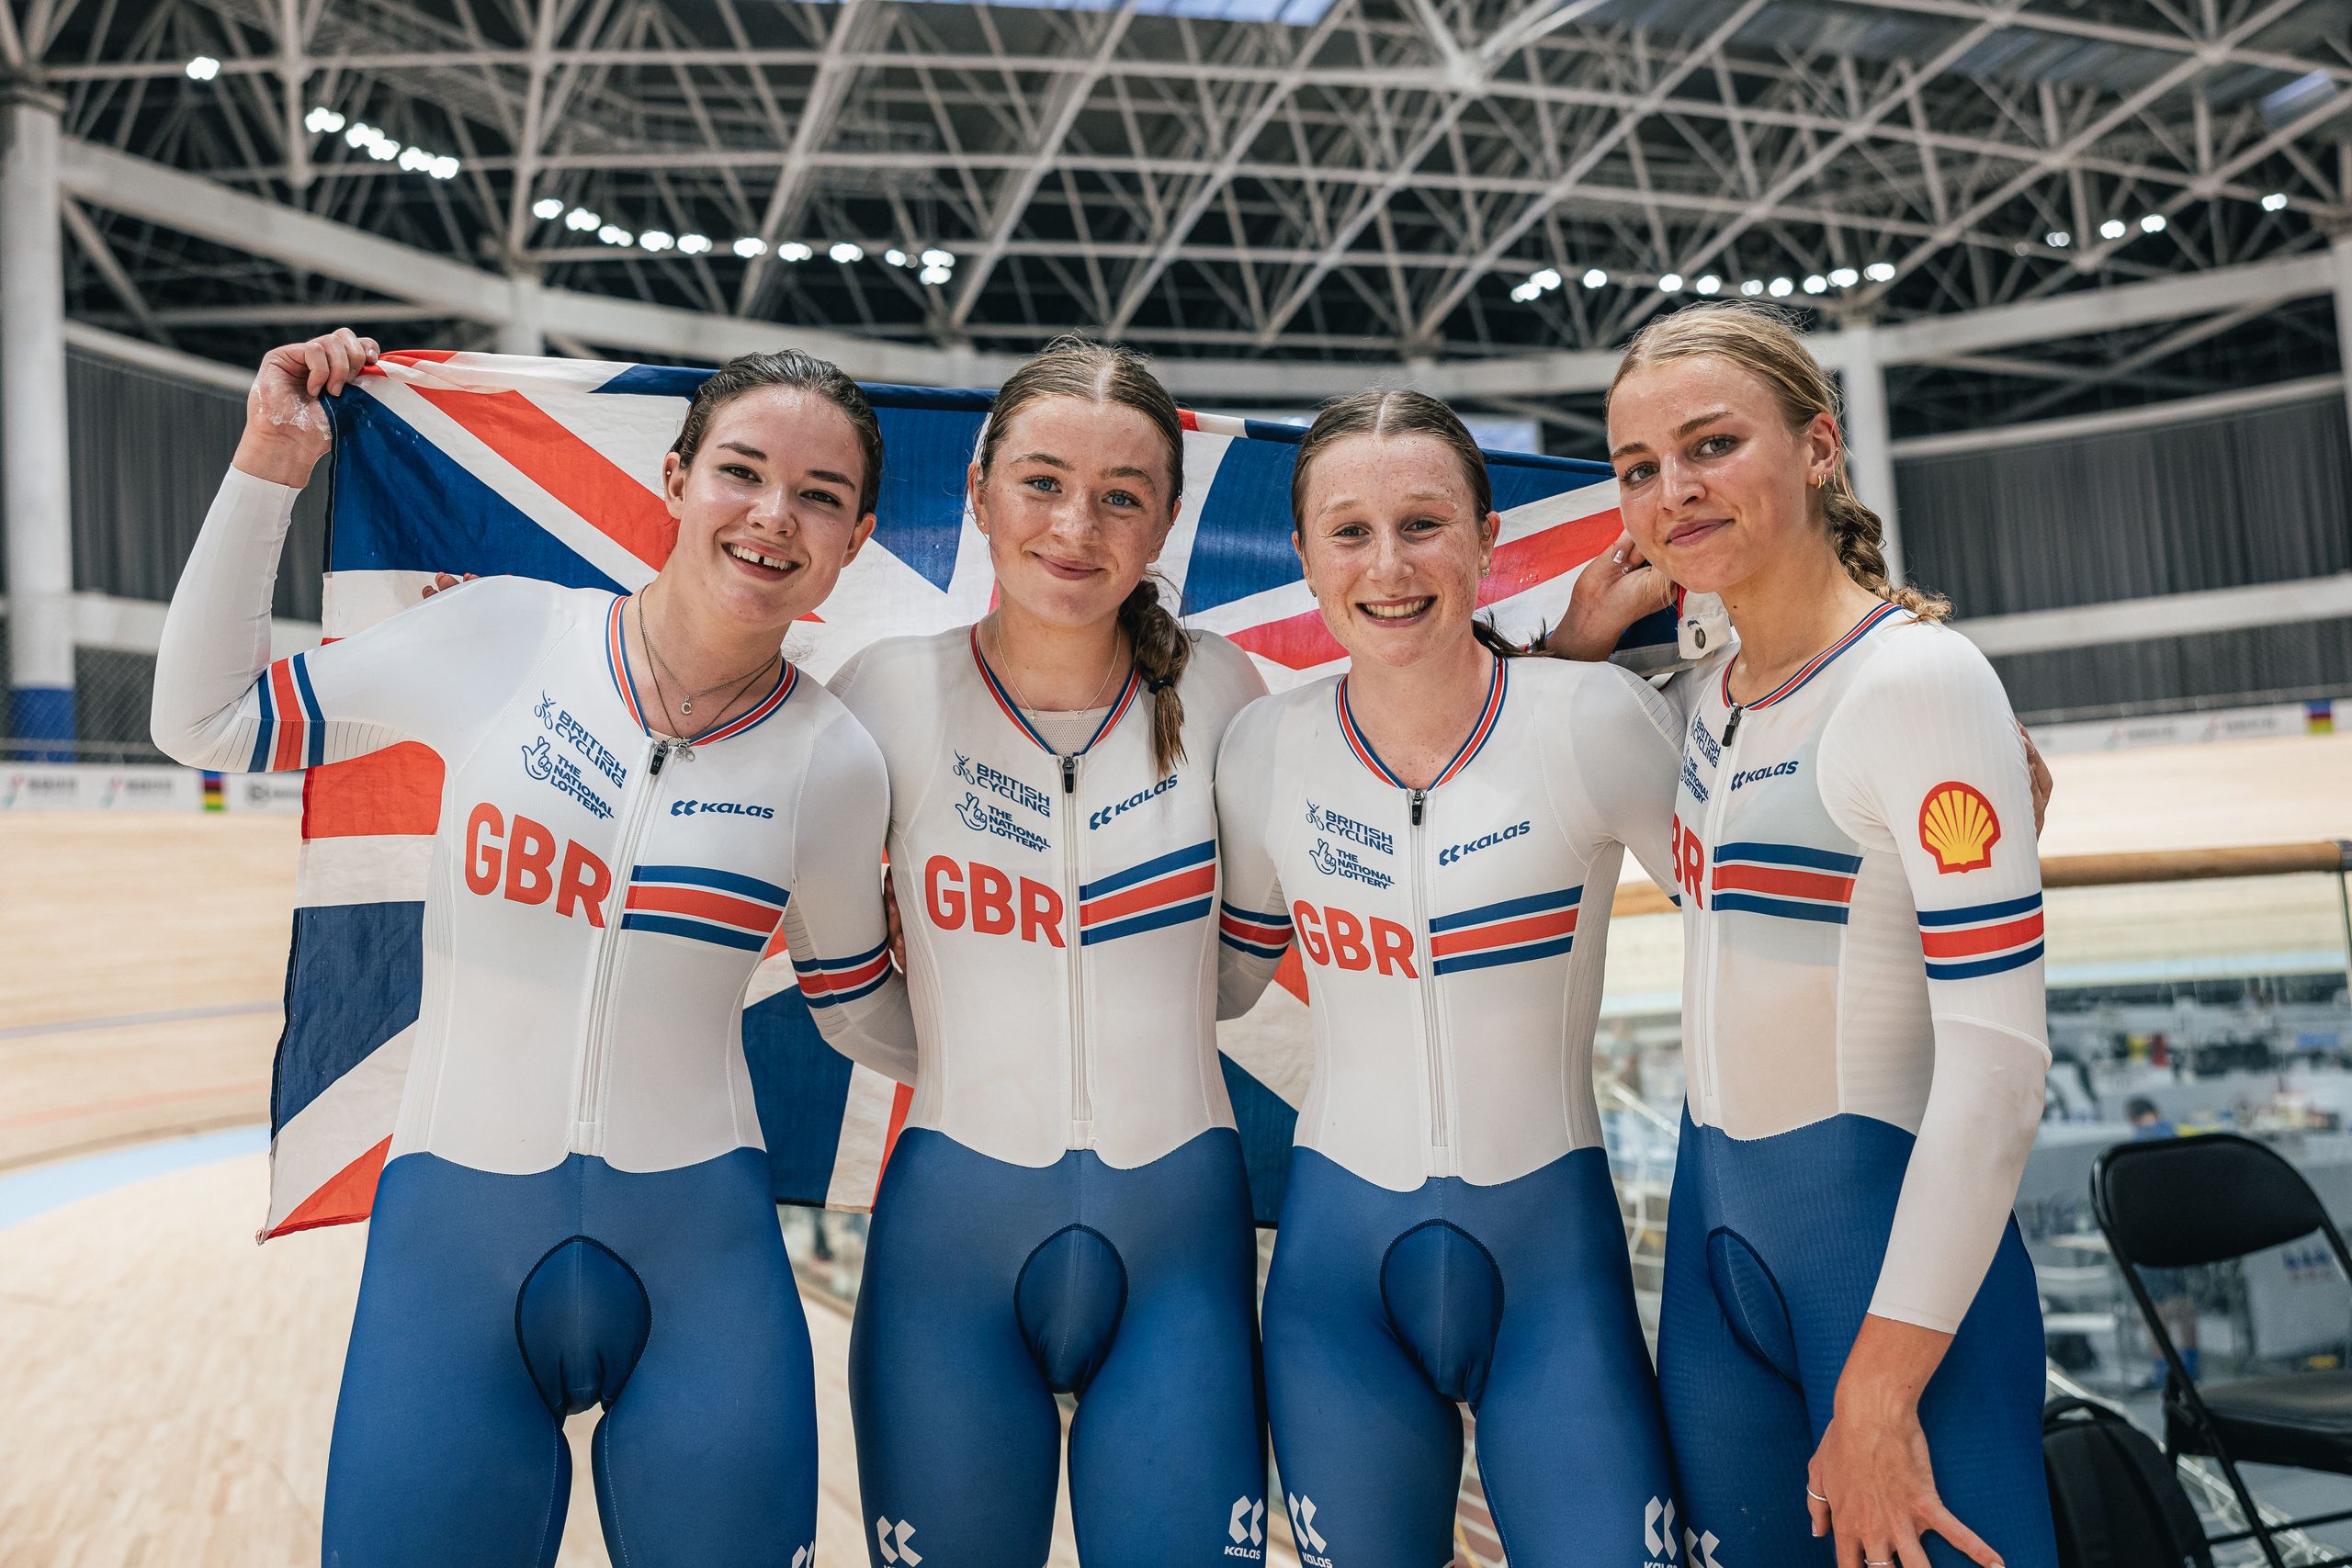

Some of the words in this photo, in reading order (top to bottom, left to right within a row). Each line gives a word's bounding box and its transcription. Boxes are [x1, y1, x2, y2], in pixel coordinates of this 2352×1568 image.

[555, 722, 624, 789] CYCLING
[558, 709, 627, 779] BRITISH
[1692, 728, 1718, 769] CYCLING
[1696, 716, 1721, 758] BRITISH
[557, 753, 582, 778] THE
[976, 761, 1050, 807] BRITISH
[1689, 756, 1698, 773] THE
[550, 774, 608, 819] LOTTERY
[553, 764, 615, 818] NATIONAL
[977, 775, 1050, 818] CYCLING
[987, 804, 1012, 821] THE
[989, 814, 1051, 848] NATIONAL
[1325, 809, 1393, 845] BRITISH
[989, 823, 1046, 852] LOTTERY
[1326, 821, 1394, 855] CYCLING
[1336, 848, 1358, 863] THE
[464, 802, 612, 929] GBR
[1337, 858, 1395, 885] NATIONAL
[1338, 866, 1390, 890] LOTTERY
[1672, 812, 1705, 910] BR
[924, 854, 1066, 948] GBR
[1293, 899, 1419, 979] GBR
